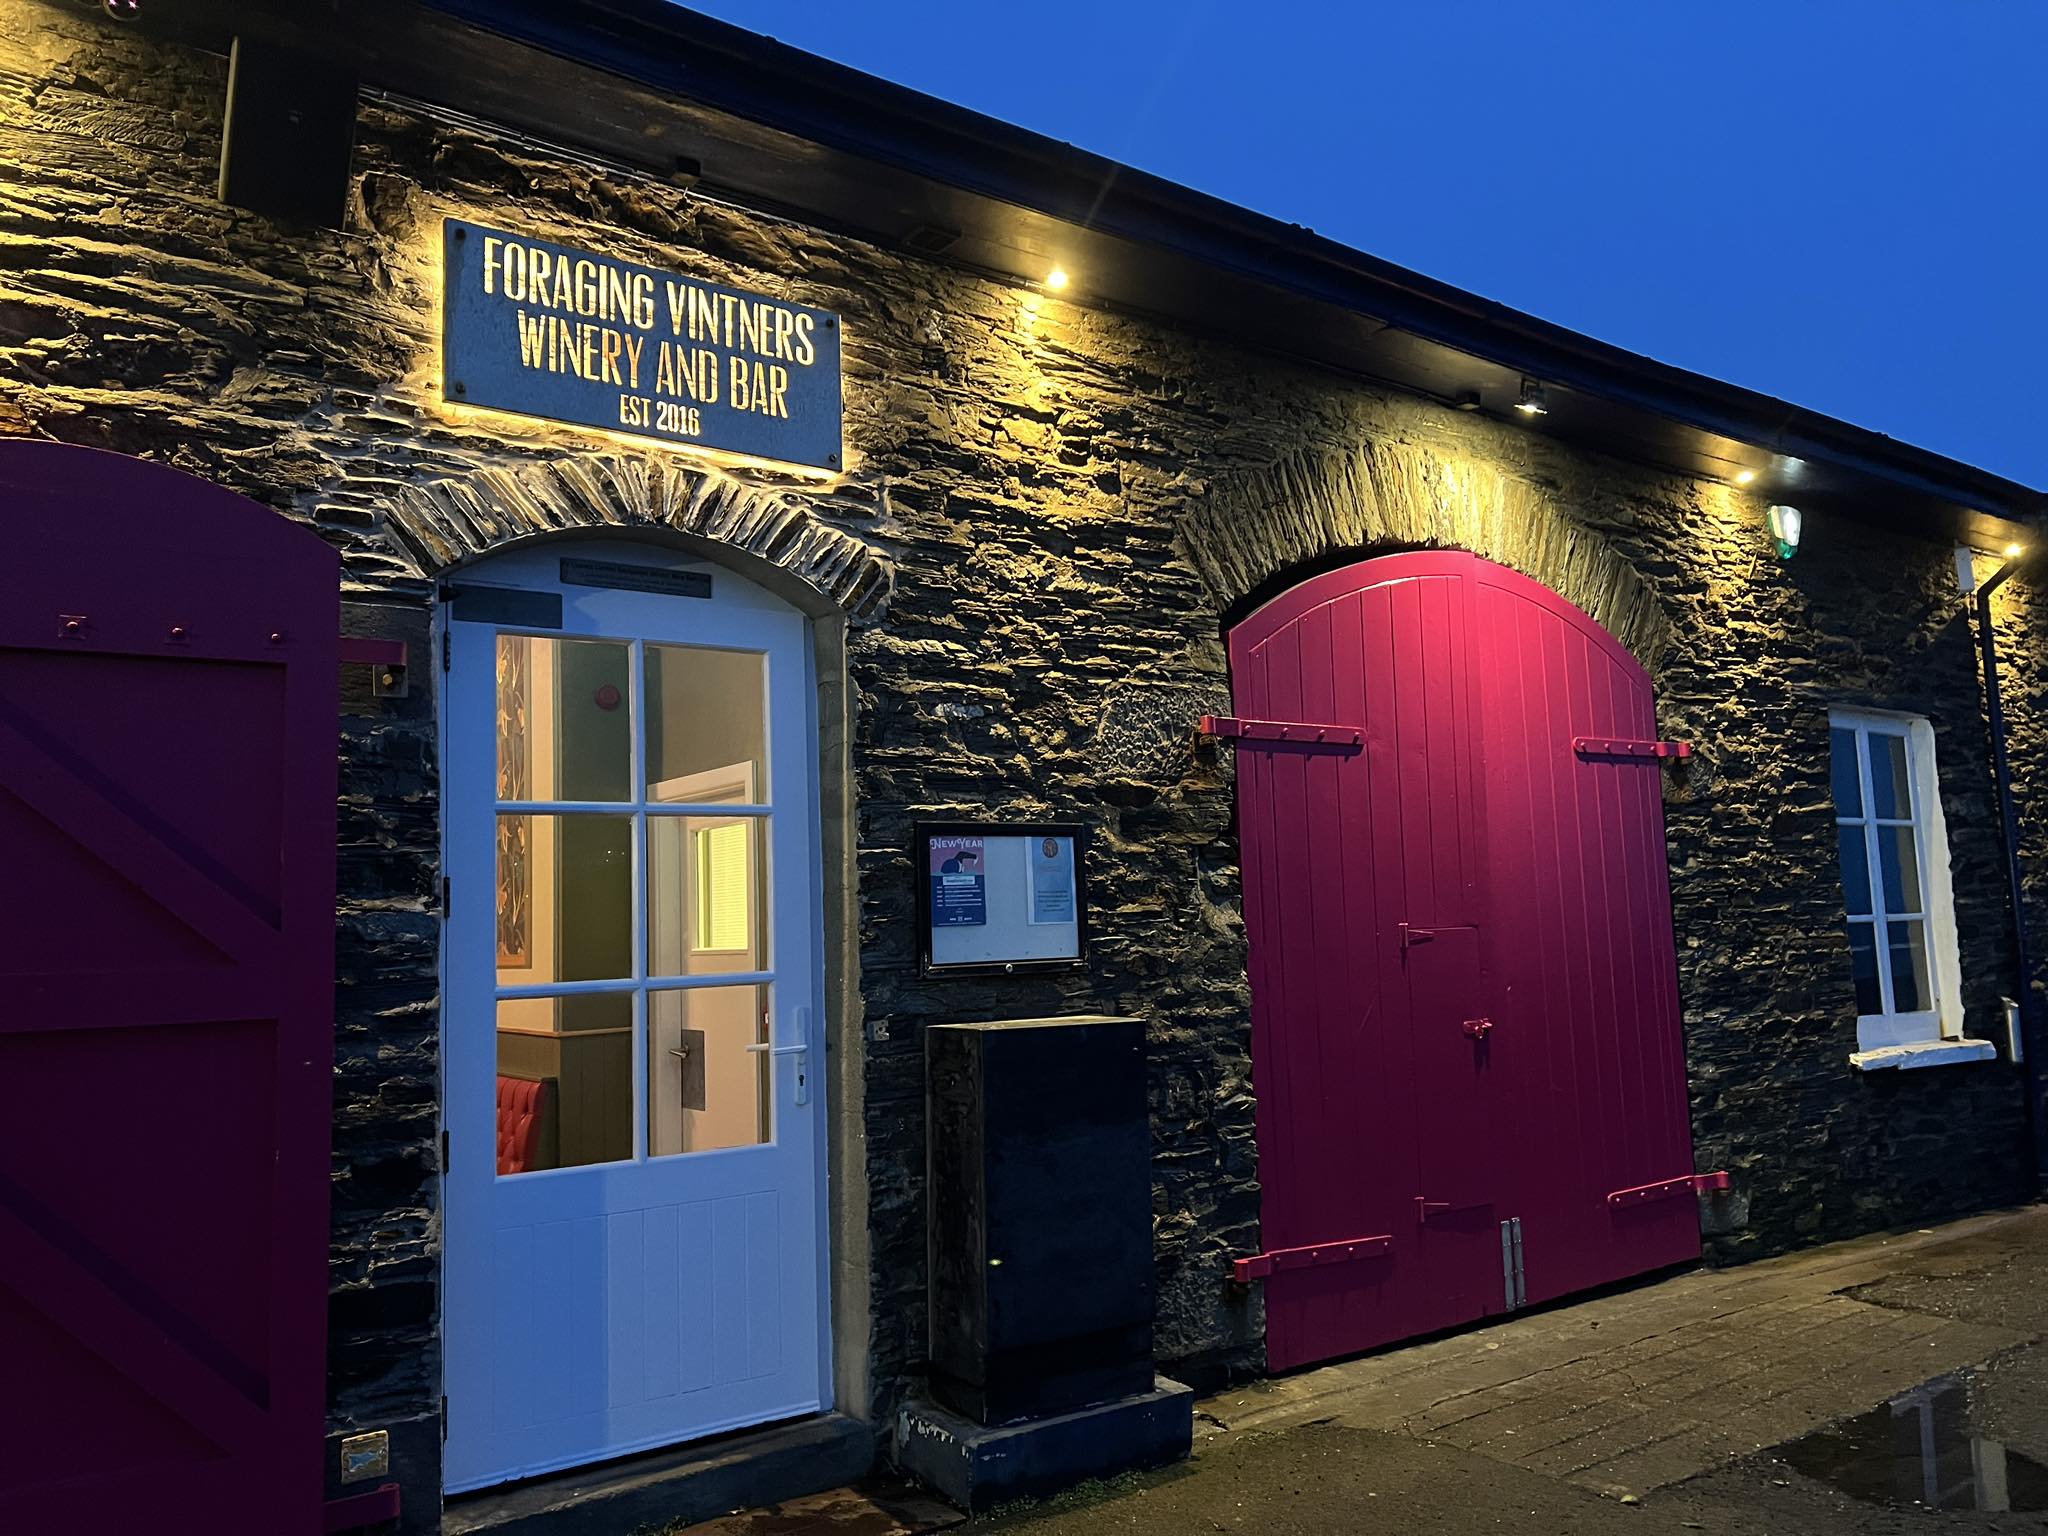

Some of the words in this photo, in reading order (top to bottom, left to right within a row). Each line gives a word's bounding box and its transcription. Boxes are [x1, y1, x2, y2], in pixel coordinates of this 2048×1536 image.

[483, 236, 655, 330] FORAGING
[666, 280, 814, 366] VINTNERS
[517, 310, 644, 389] WINERY
[655, 341, 718, 404] AND
[729, 356, 789, 419] BAR
[619, 393, 650, 428] EST
[656, 401, 700, 437] 2016
